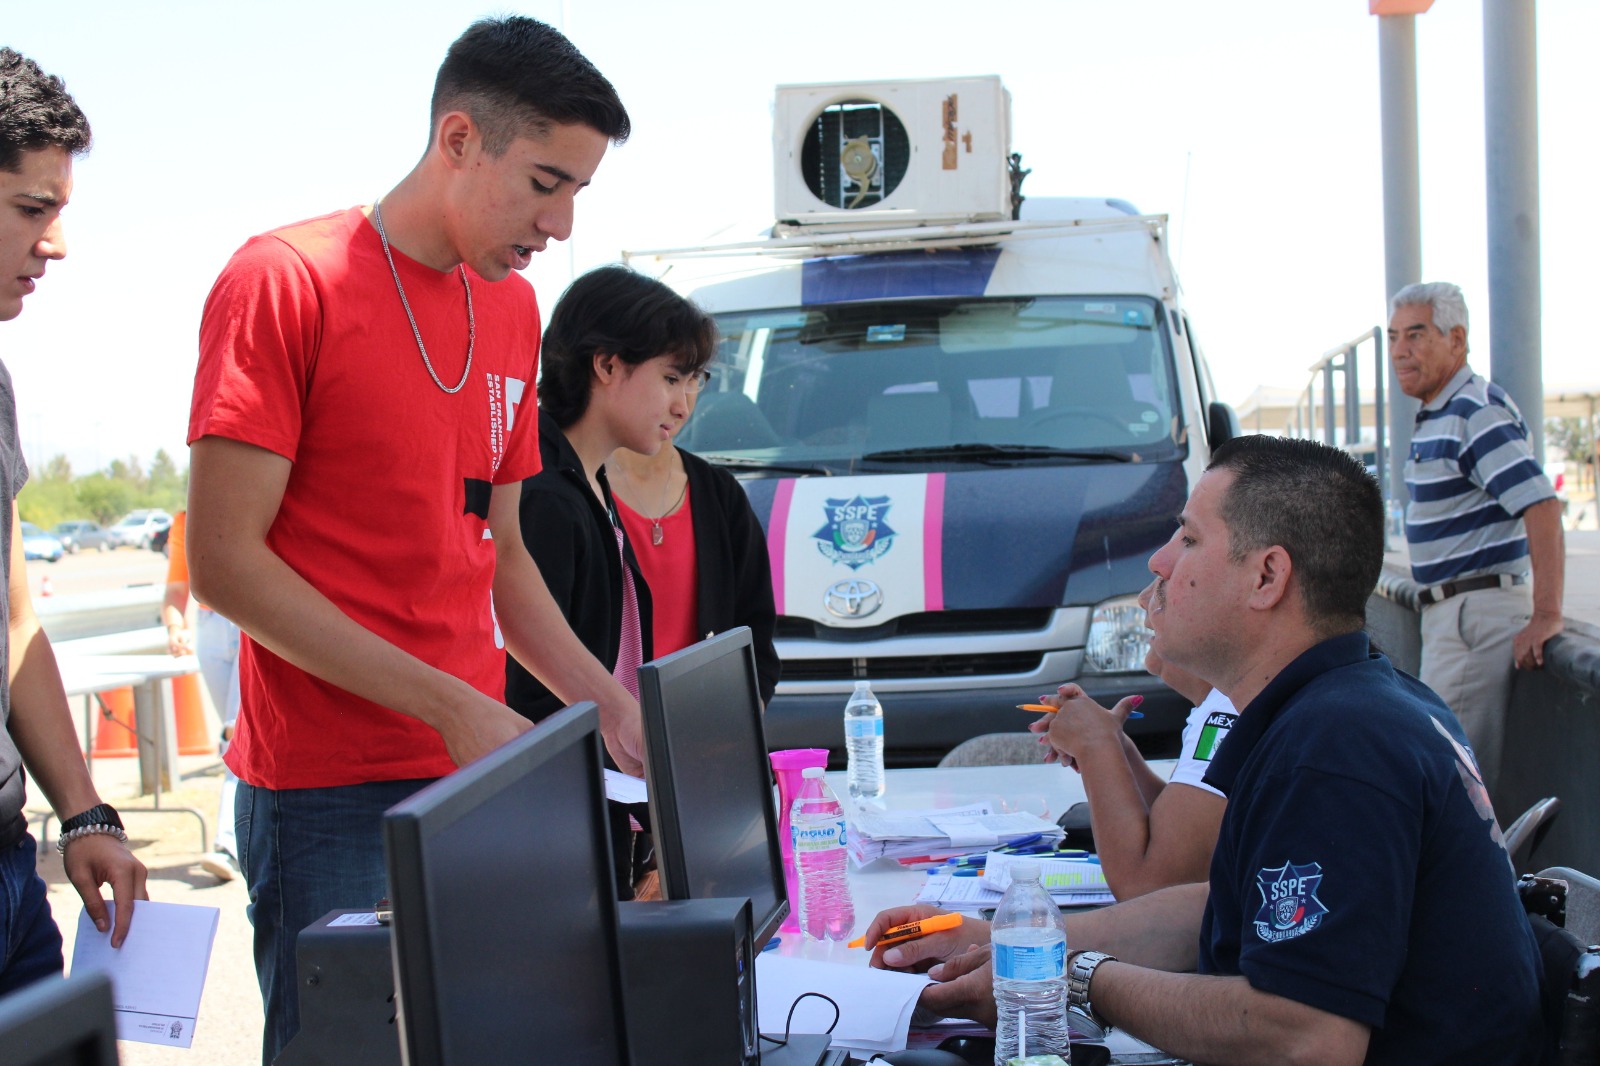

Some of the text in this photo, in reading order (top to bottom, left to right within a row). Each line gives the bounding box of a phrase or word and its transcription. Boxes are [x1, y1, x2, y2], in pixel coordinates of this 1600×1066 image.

[494, 374, 502, 398] SAN
[487, 372, 498, 454] ESTABLISHED
[834, 506, 878, 521] SSPE
[1271, 878, 1307, 900] SSPE
